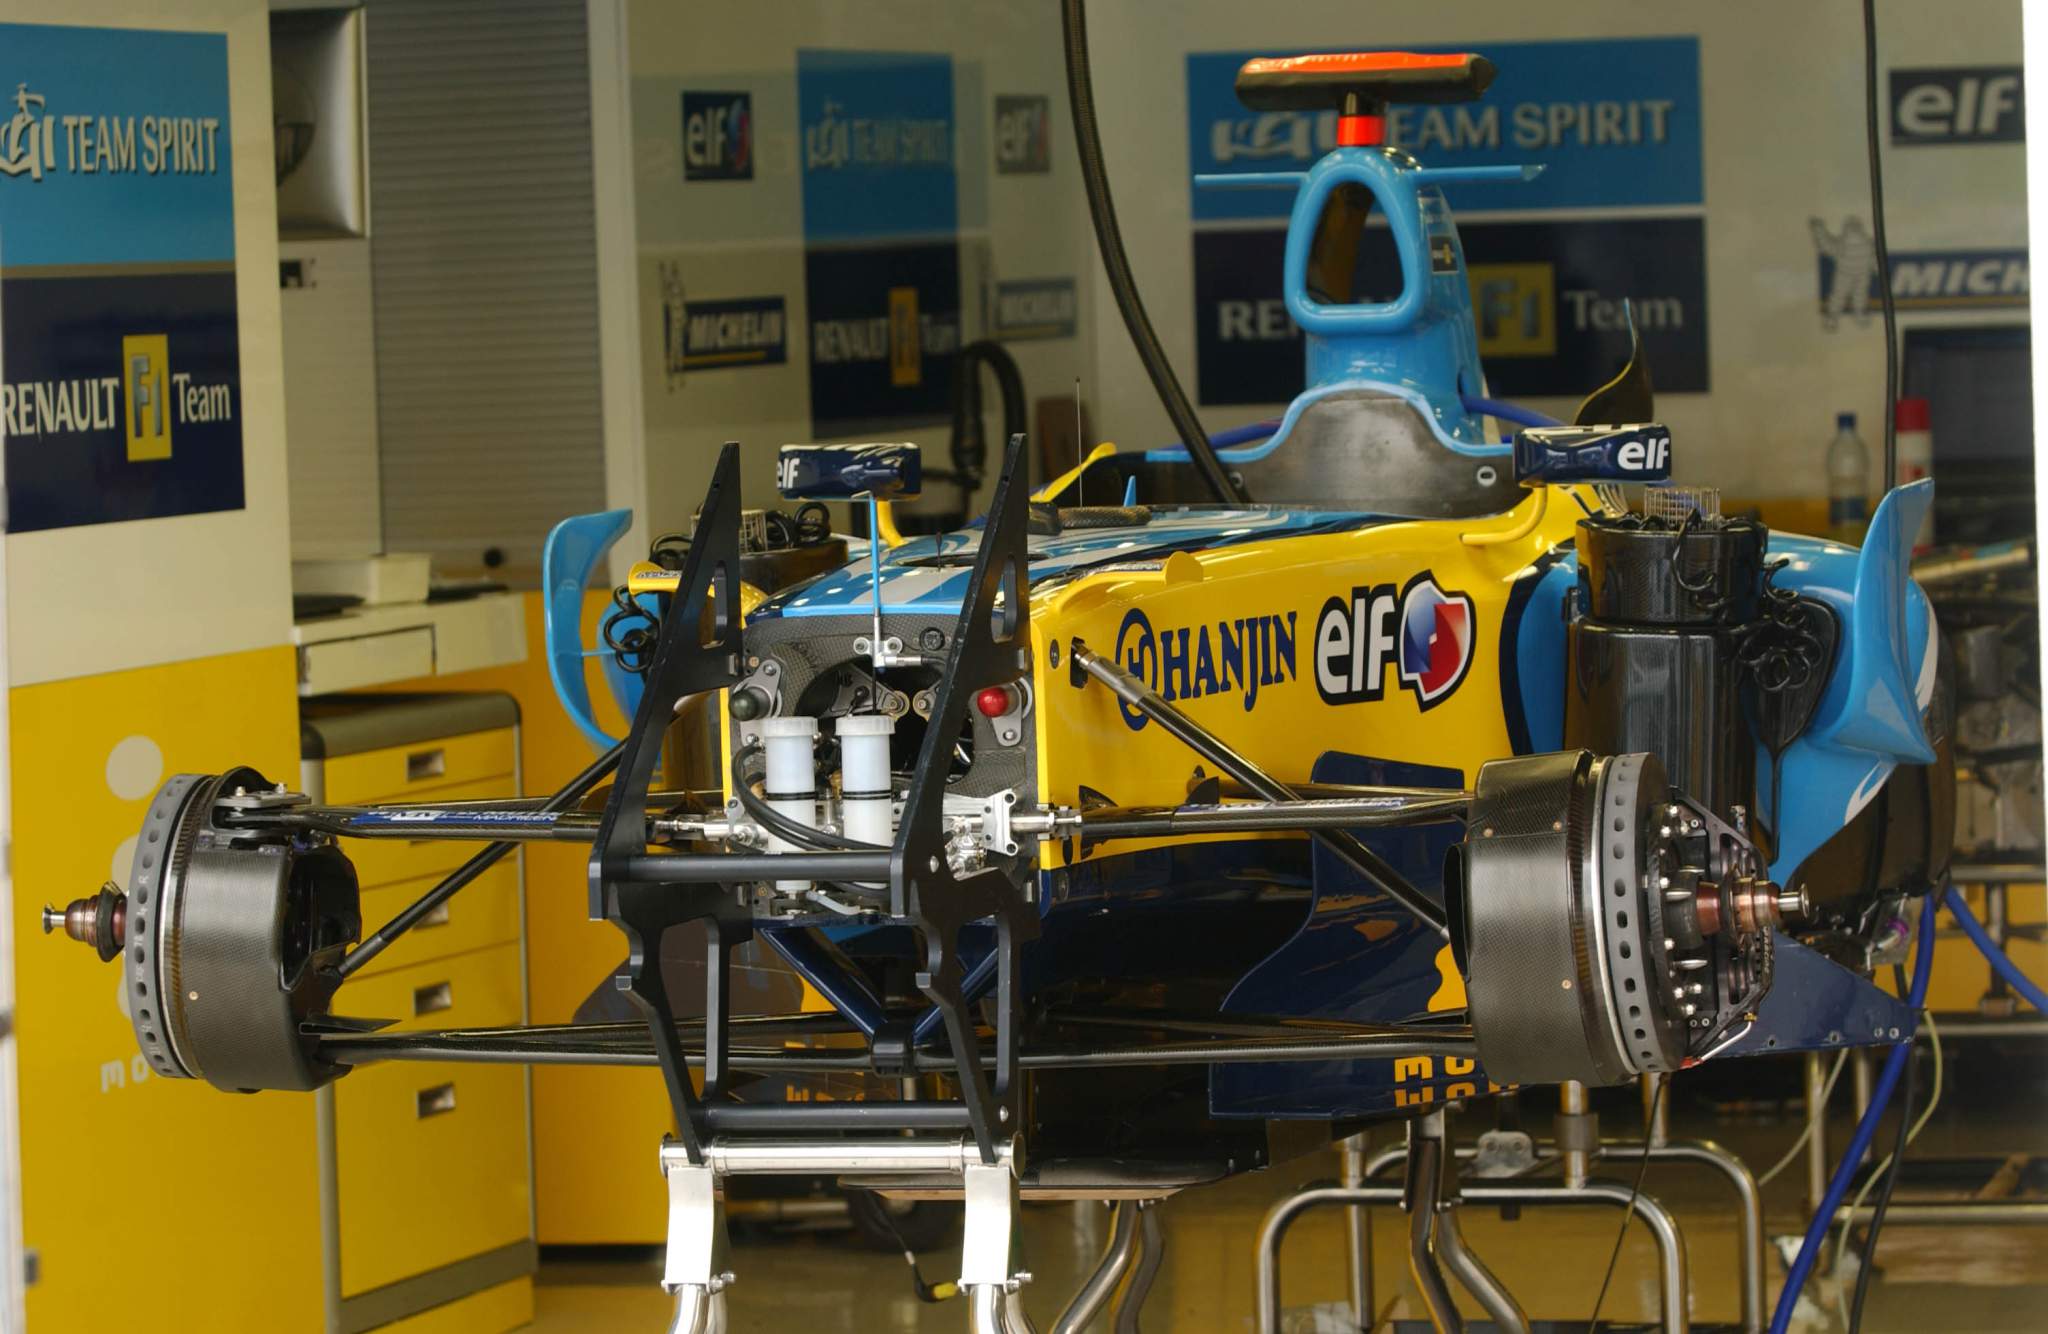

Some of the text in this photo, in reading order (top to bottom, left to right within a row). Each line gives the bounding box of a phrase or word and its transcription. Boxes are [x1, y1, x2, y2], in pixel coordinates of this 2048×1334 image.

[1384, 100, 1675, 148] EAM SPIRIT
[1899, 76, 2019, 135] elf
[63, 115, 220, 174] TEAM SPIRIT
[687, 106, 728, 168] elf
[688, 311, 783, 350] MICHELIN
[1480, 276, 1539, 341] F1
[1566, 293, 1683, 332] Team
[2, 354, 232, 439] RENAULT F1 Team
[1617, 437, 1670, 471] elf
[1159, 610, 1298, 712] HANJIN
[1316, 590, 1400, 697] elf
